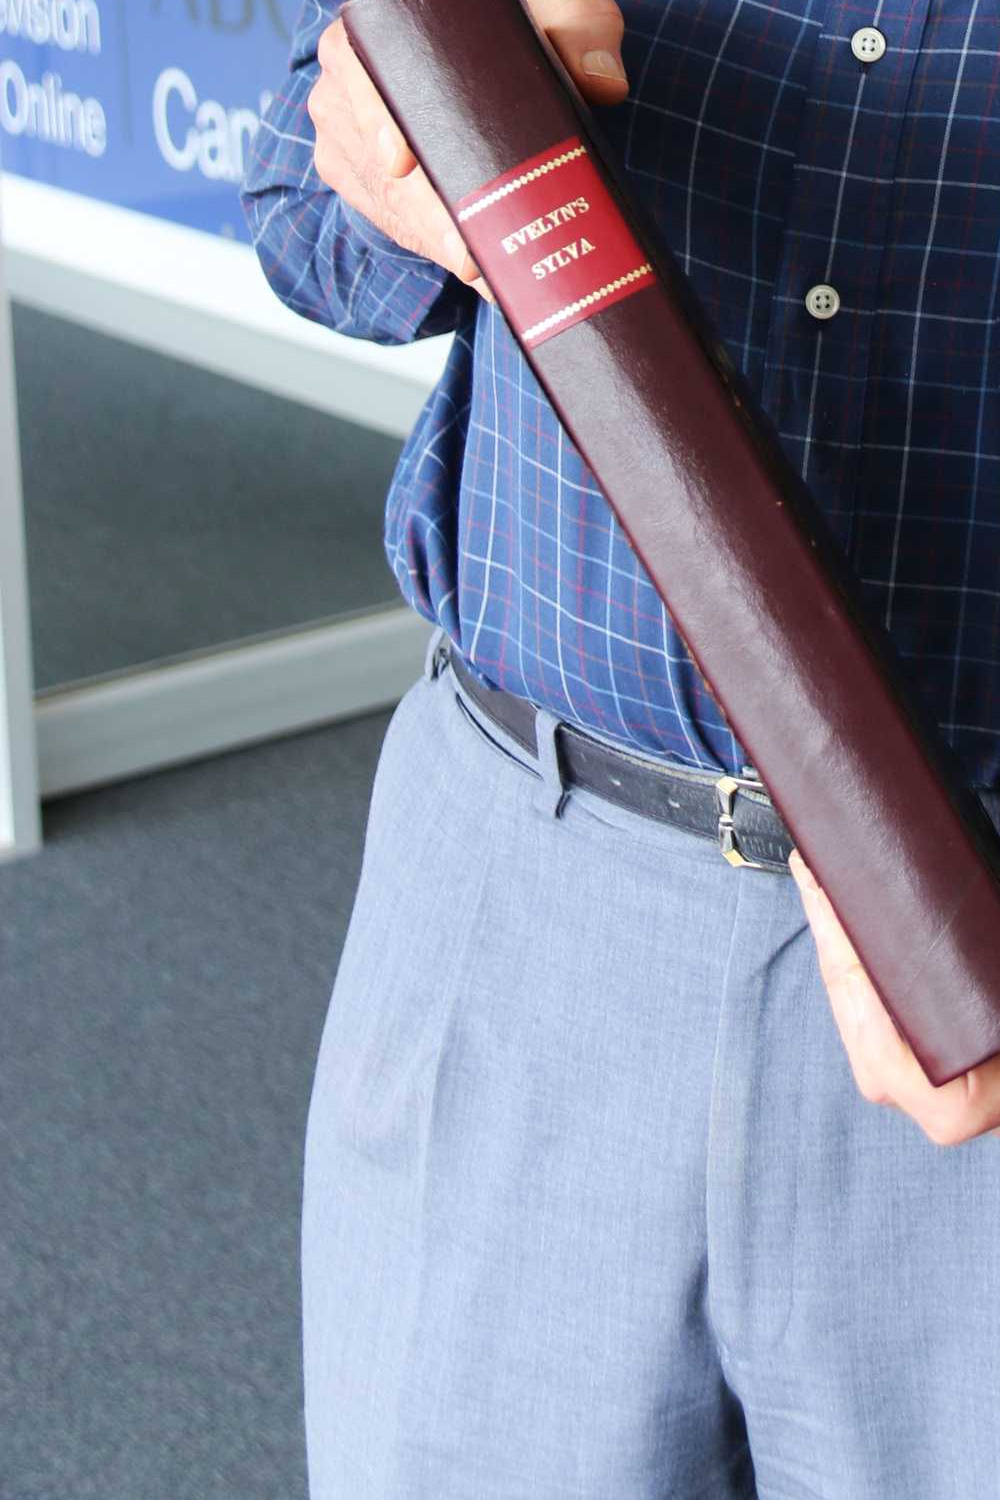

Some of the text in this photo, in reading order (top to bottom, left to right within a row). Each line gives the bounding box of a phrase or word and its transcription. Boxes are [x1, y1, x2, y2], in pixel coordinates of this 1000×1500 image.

[0, 60, 107, 157] Online
[152, 67, 273, 184] Can
[501, 197, 590, 254] EVELYN'S
[531, 238, 596, 281] SYLVA
